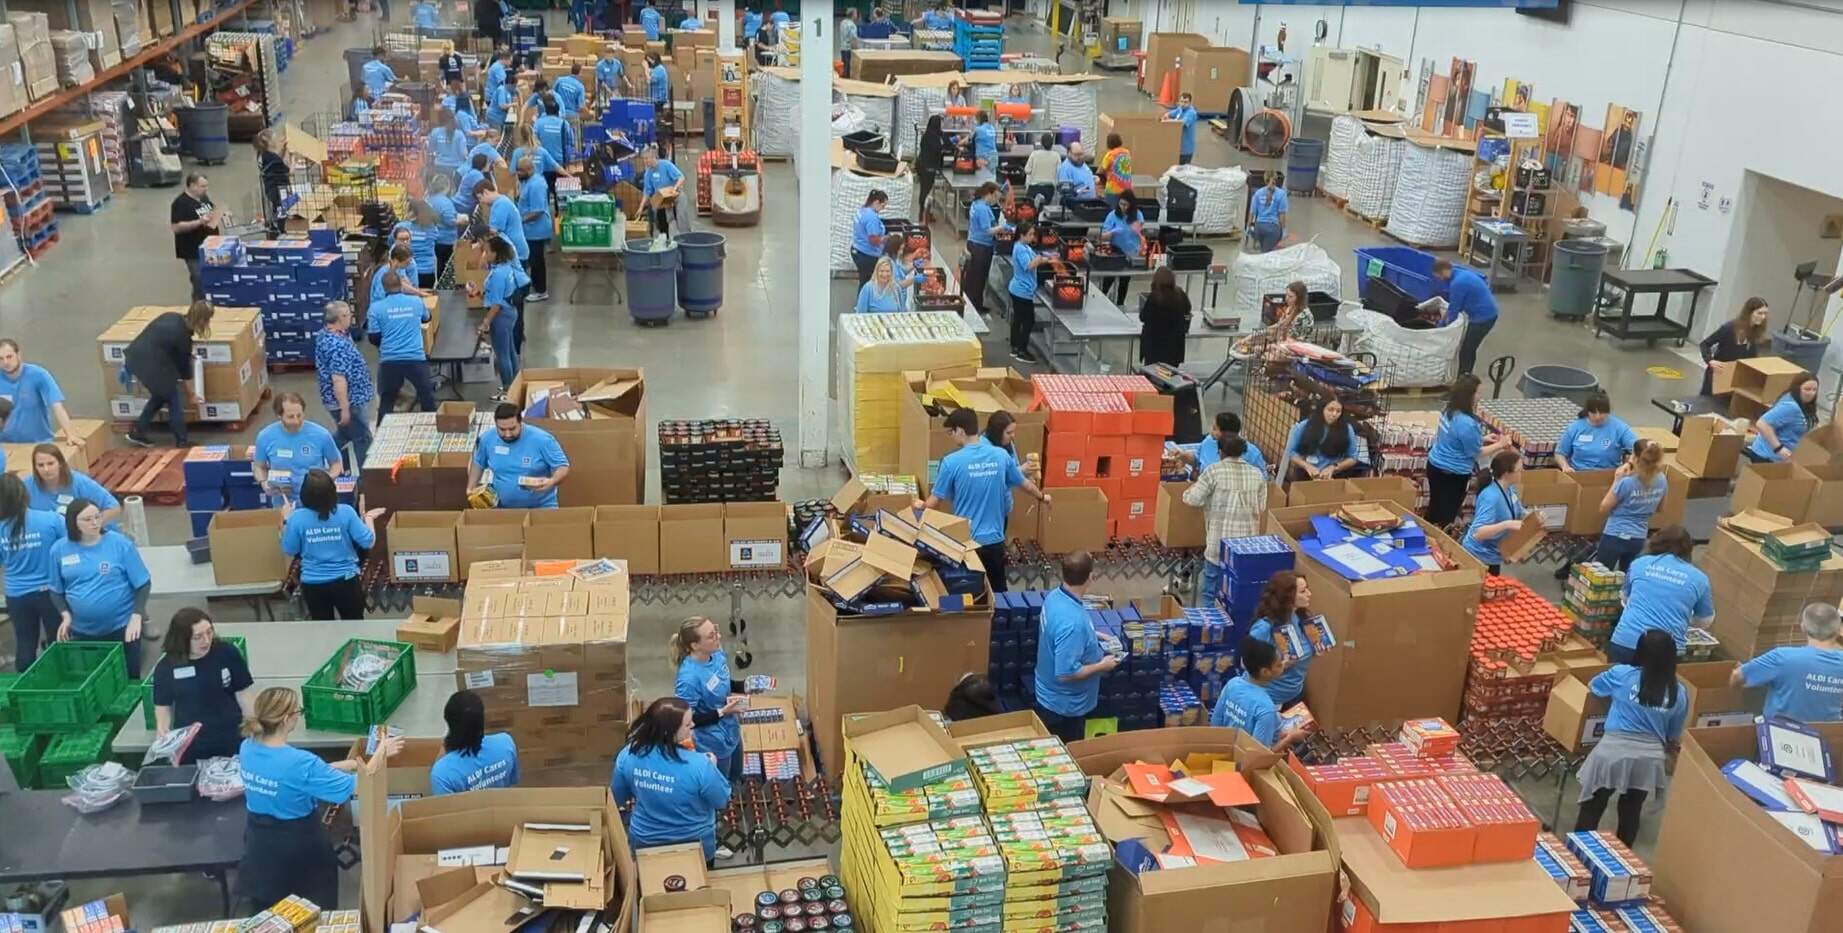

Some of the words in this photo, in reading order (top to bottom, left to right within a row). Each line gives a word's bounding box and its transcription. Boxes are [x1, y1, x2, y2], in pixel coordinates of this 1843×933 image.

[812, 18, 822, 37] 1
[305, 528, 321, 537] ALDI
[306, 535, 342, 543] Volunteer
[1806, 672, 1826, 682] ALDI
[467, 768, 483, 784] ALDI
[484, 759, 507, 774] Cares
[633, 767, 651, 778] ALDI
[652, 771, 675, 783] Cares
[255, 775, 278, 788] Cares
[633, 777, 673, 793] Volunteer
